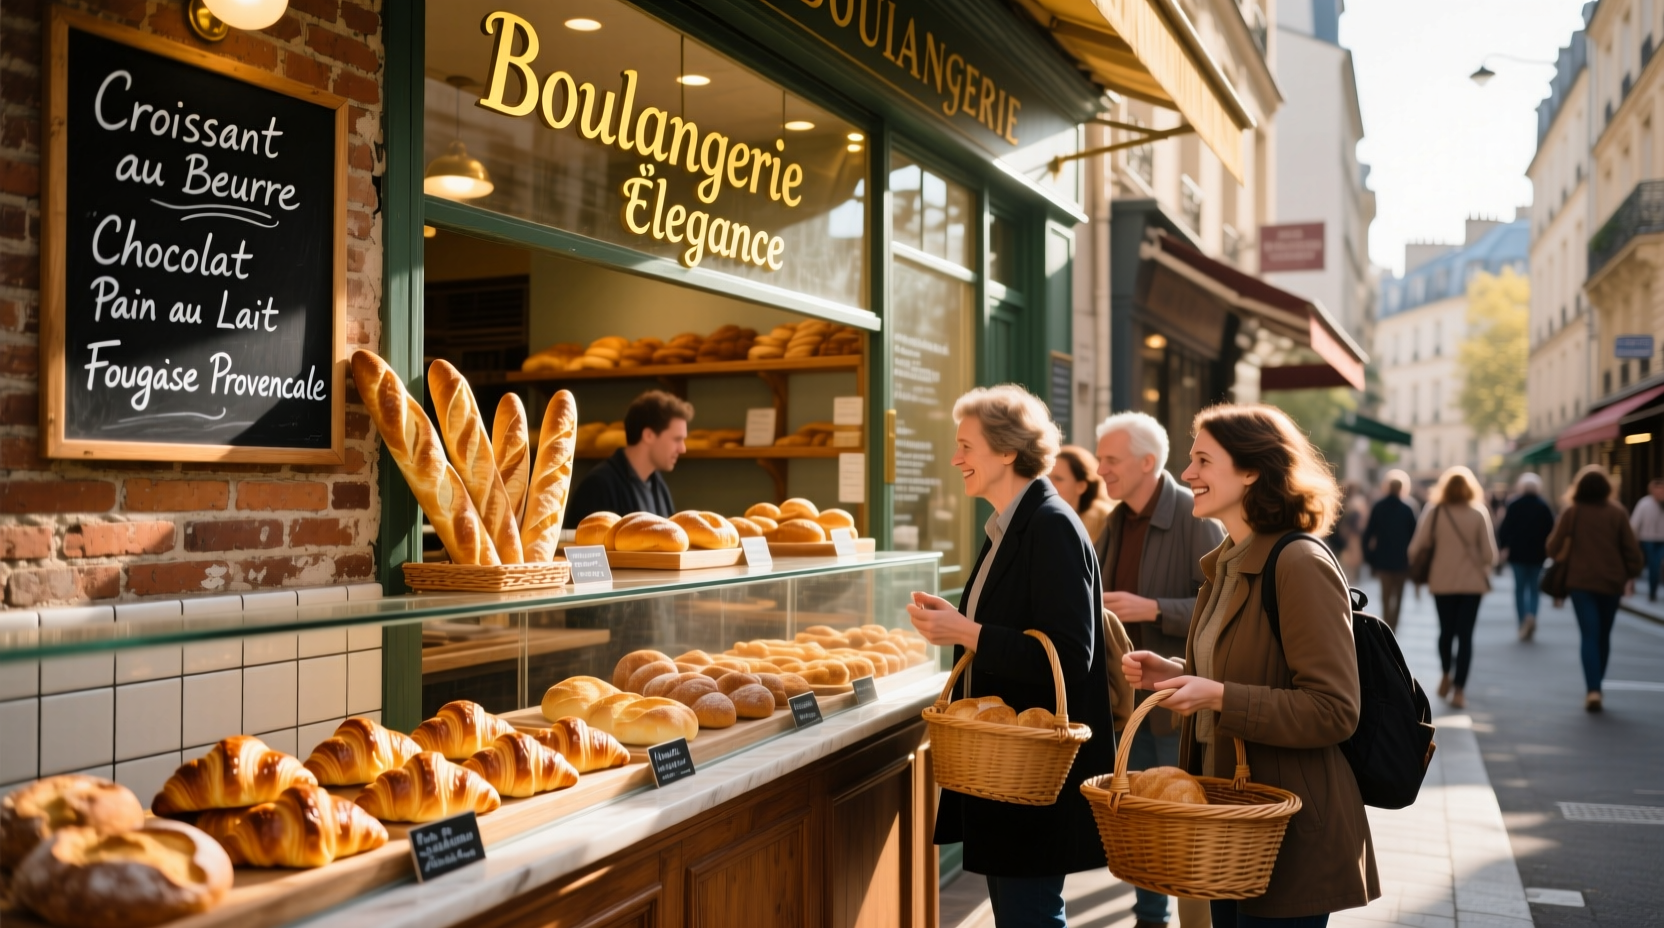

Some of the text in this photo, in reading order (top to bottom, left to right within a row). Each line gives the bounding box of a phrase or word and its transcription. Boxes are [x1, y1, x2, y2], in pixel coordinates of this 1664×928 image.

[802, 0, 1021, 145] UIANGERIE
[95, 70, 284, 159] Croissant
[479, 11, 803, 207] Boulangerie
[115, 153, 300, 211] au Beurre
[92, 214, 254, 280] Chocolat
[90, 275, 280, 333] Pain au Lait
[209, 352, 327, 401] Provencale
